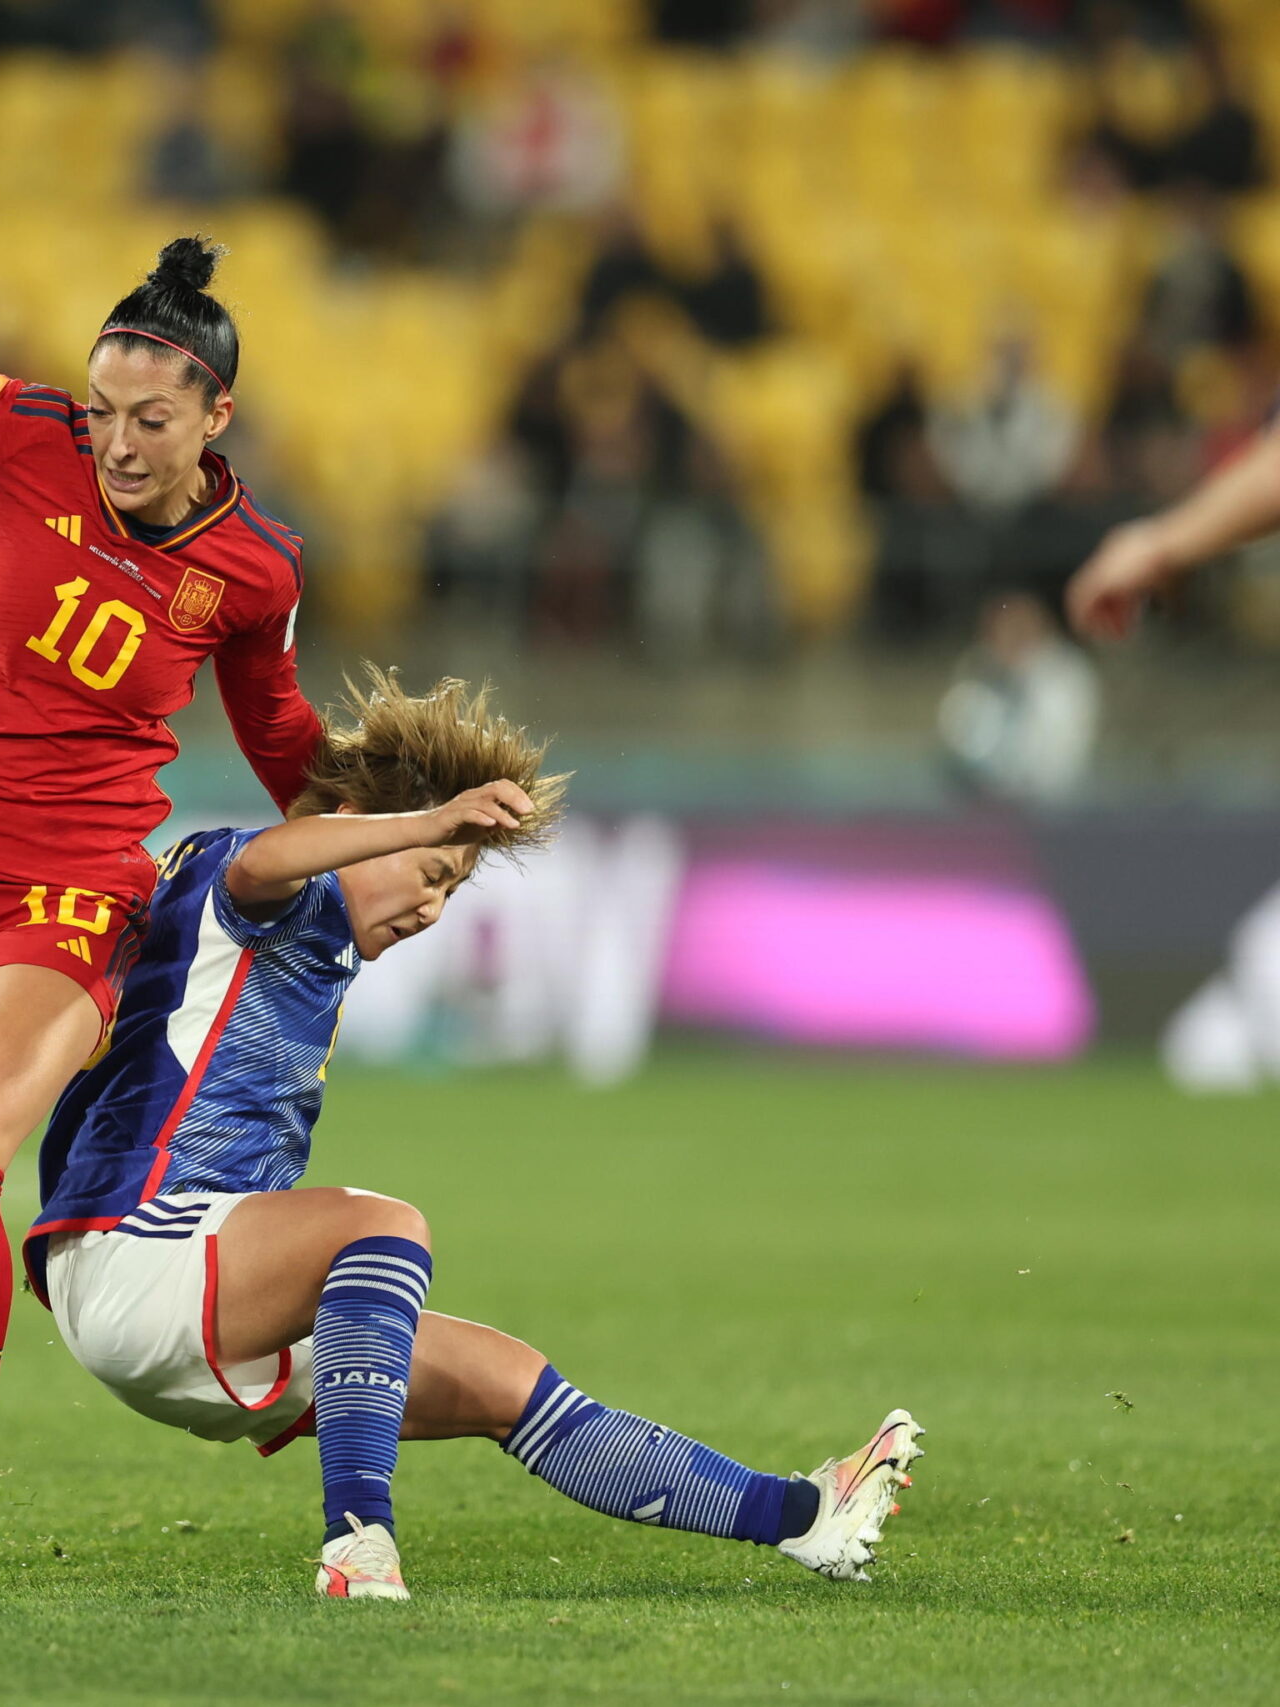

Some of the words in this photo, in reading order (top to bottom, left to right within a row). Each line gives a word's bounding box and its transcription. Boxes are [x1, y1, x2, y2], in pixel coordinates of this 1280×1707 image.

[25, 575, 147, 690] 10
[15, 885, 118, 935] 10
[325, 1371, 408, 1398] JAPA
